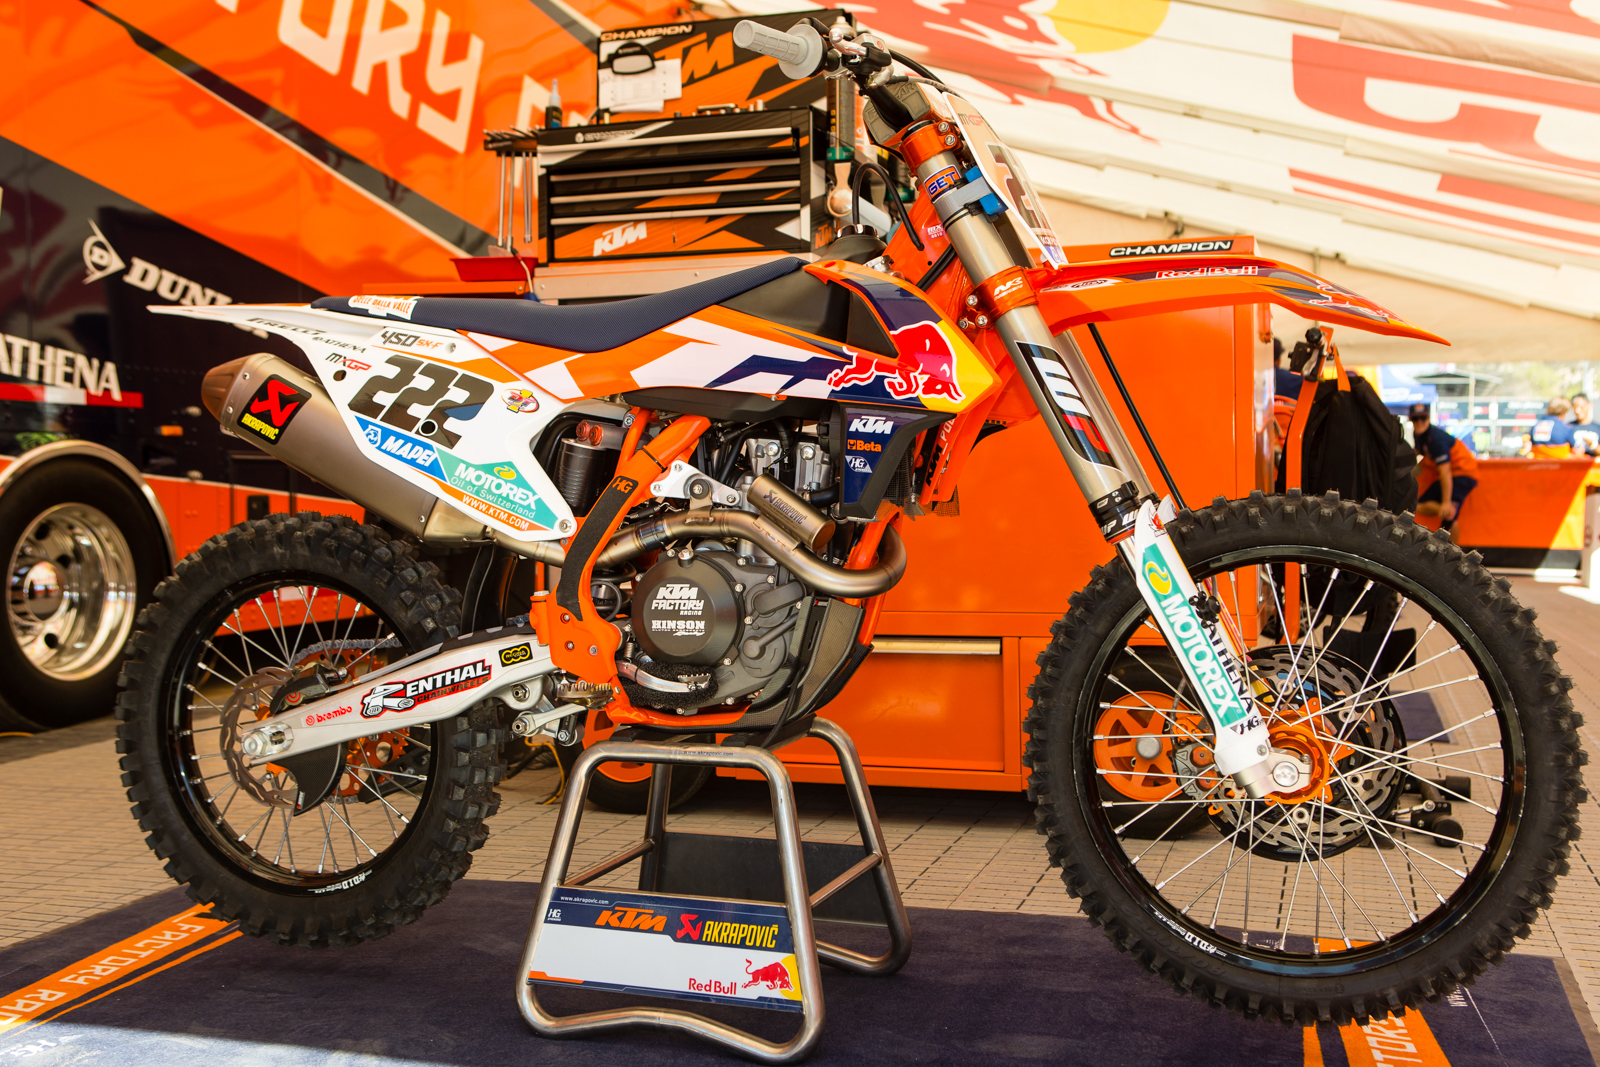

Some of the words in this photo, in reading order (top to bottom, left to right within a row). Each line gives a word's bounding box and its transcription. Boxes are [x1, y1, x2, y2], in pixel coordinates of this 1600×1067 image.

[600, 24, 693, 42] CHAMPION
[927, 171, 957, 196] GET
[593, 221, 648, 257] KTM
[815, 224, 832, 249] KTM
[1110, 240, 1232, 256] CHAMPION
[1155, 267, 1207, 280] Red
[1208, 266, 1258, 276] Bull
[353, 296, 372, 305] SELLE
[372, 299, 391, 308] DALLA
[393, 301, 411, 314] VALLE
[323, 339, 367, 354] ATHENA
[380, 330, 420, 347] 450
[325, 352, 372, 371] MXGP
[347, 354, 495, 450] 222
[849, 415, 894, 435] KTM
[380, 435, 437, 468] MAPEI
[856, 440, 882, 452] Beta
[850, 457, 865, 469] HG
[925, 443, 943, 487] KTM
[454, 462, 541, 510] MOTOREX
[615, 476, 633, 494] HG
[450, 477, 465, 490] Oil
[466, 484, 478, 496] of
[479, 489, 536, 519] Switzerland
[462, 494, 530, 532] WWW.KTM.COM
[656, 583, 698, 600] KTM
[651, 599, 705, 610] FACTORY
[651, 619, 705, 630] HINSON
[1160, 592, 1242, 720] MOTOREX
[362, 663, 490, 718] RENTHAL
[416, 675, 490, 703] CHAINWHEELS
[316, 705, 353, 723] brembo
[560, 896, 609, 905] www.akrapovic.com
[547, 908, 562, 918] HG
[595, 906, 668, 932] KTM
[58, 922, 206, 986] FACTORY
[688, 977, 713, 993] Red
[713, 980, 737, 996] Bull
